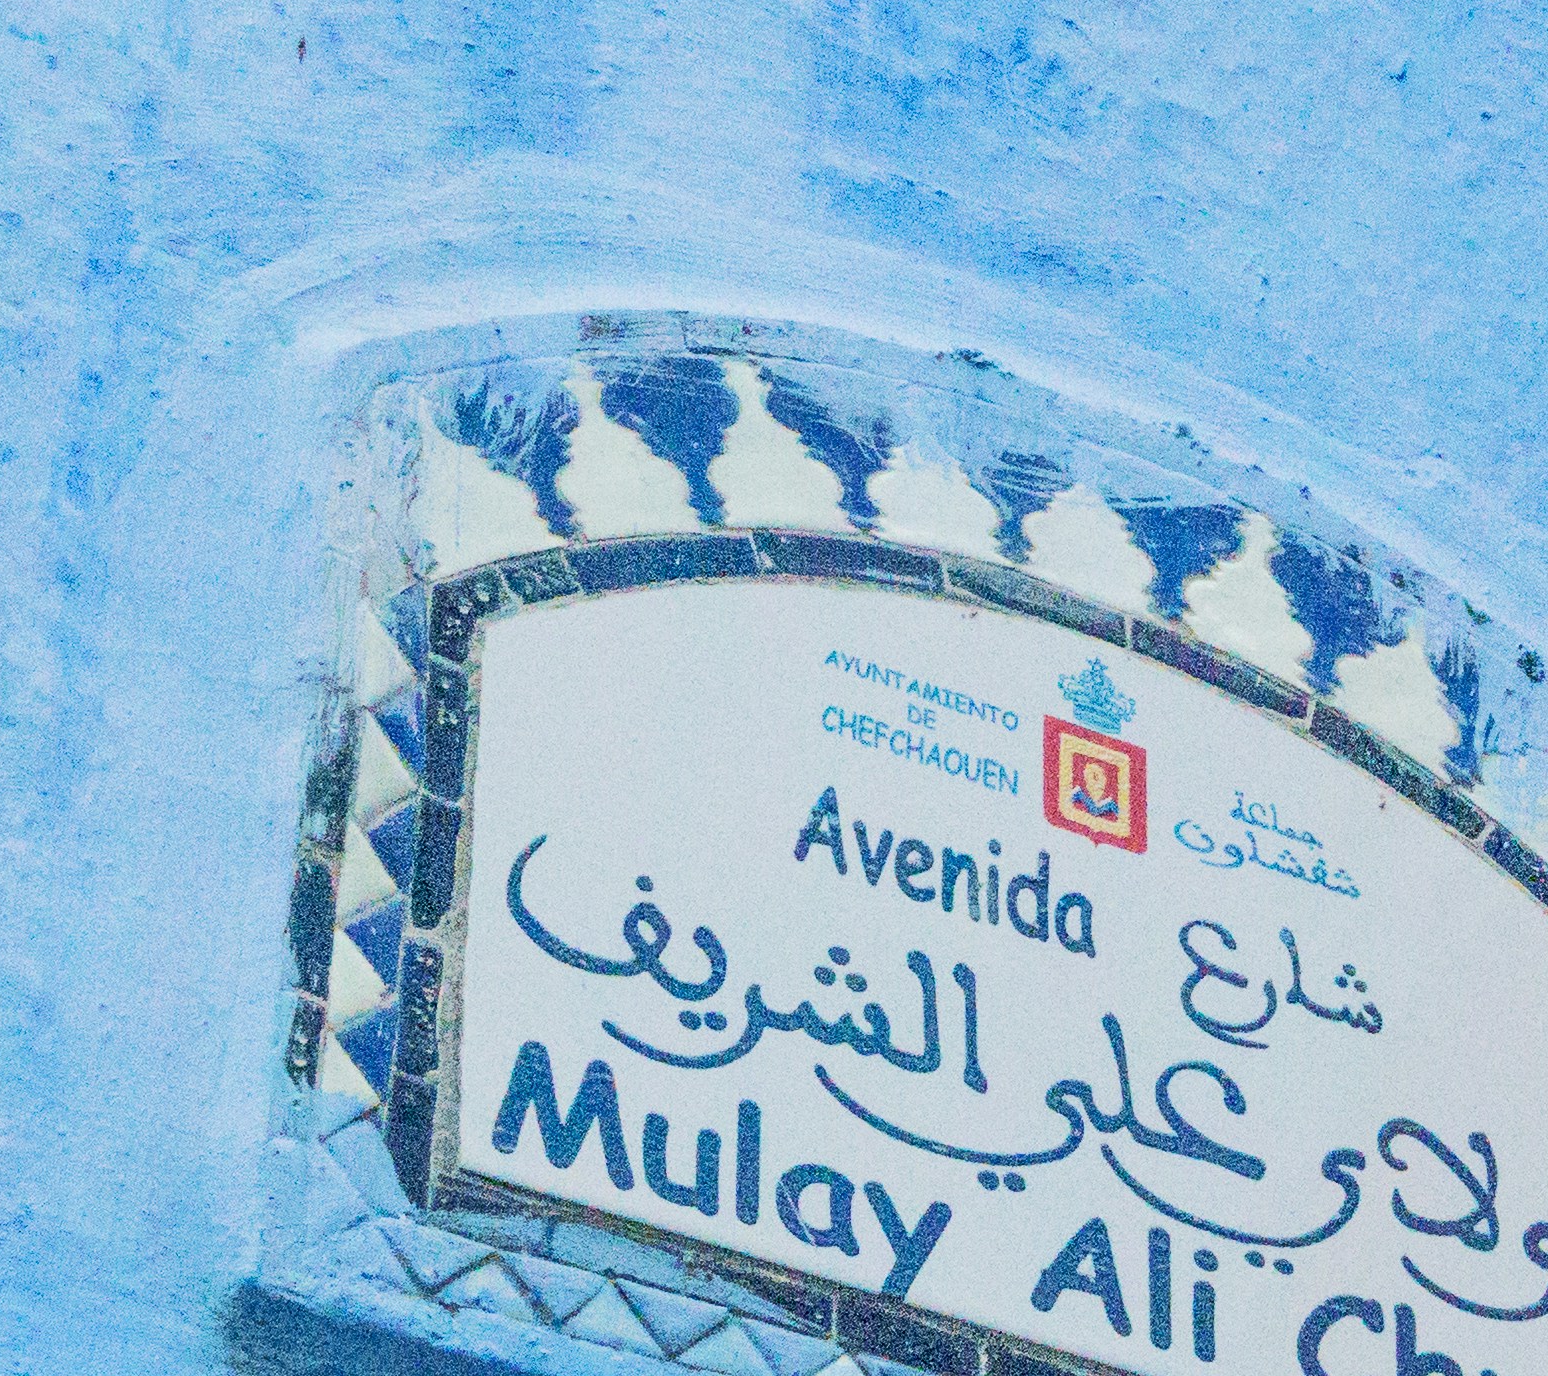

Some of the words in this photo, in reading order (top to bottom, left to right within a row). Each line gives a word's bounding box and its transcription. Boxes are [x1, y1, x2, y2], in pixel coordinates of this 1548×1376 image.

[823, 650, 1020, 732] AYUNTAMIENTO
[906, 702, 938, 731] DE
[820, 704, 1020, 797] CHEFCHAOUEN
[793, 784, 1096, 959] Avenida
[1173, 819, 1362, 900] شفشاون
[1229, 789, 1324, 852] جماعة
[506, 834, 989, 1094] الشريف
[1179, 918, 1384, 1049] شارع
[814, 1012, 1267, 1192] علي
[491, 1040, 953, 1300] Mulay
[1031, 1217, 1218, 1364] Ali
